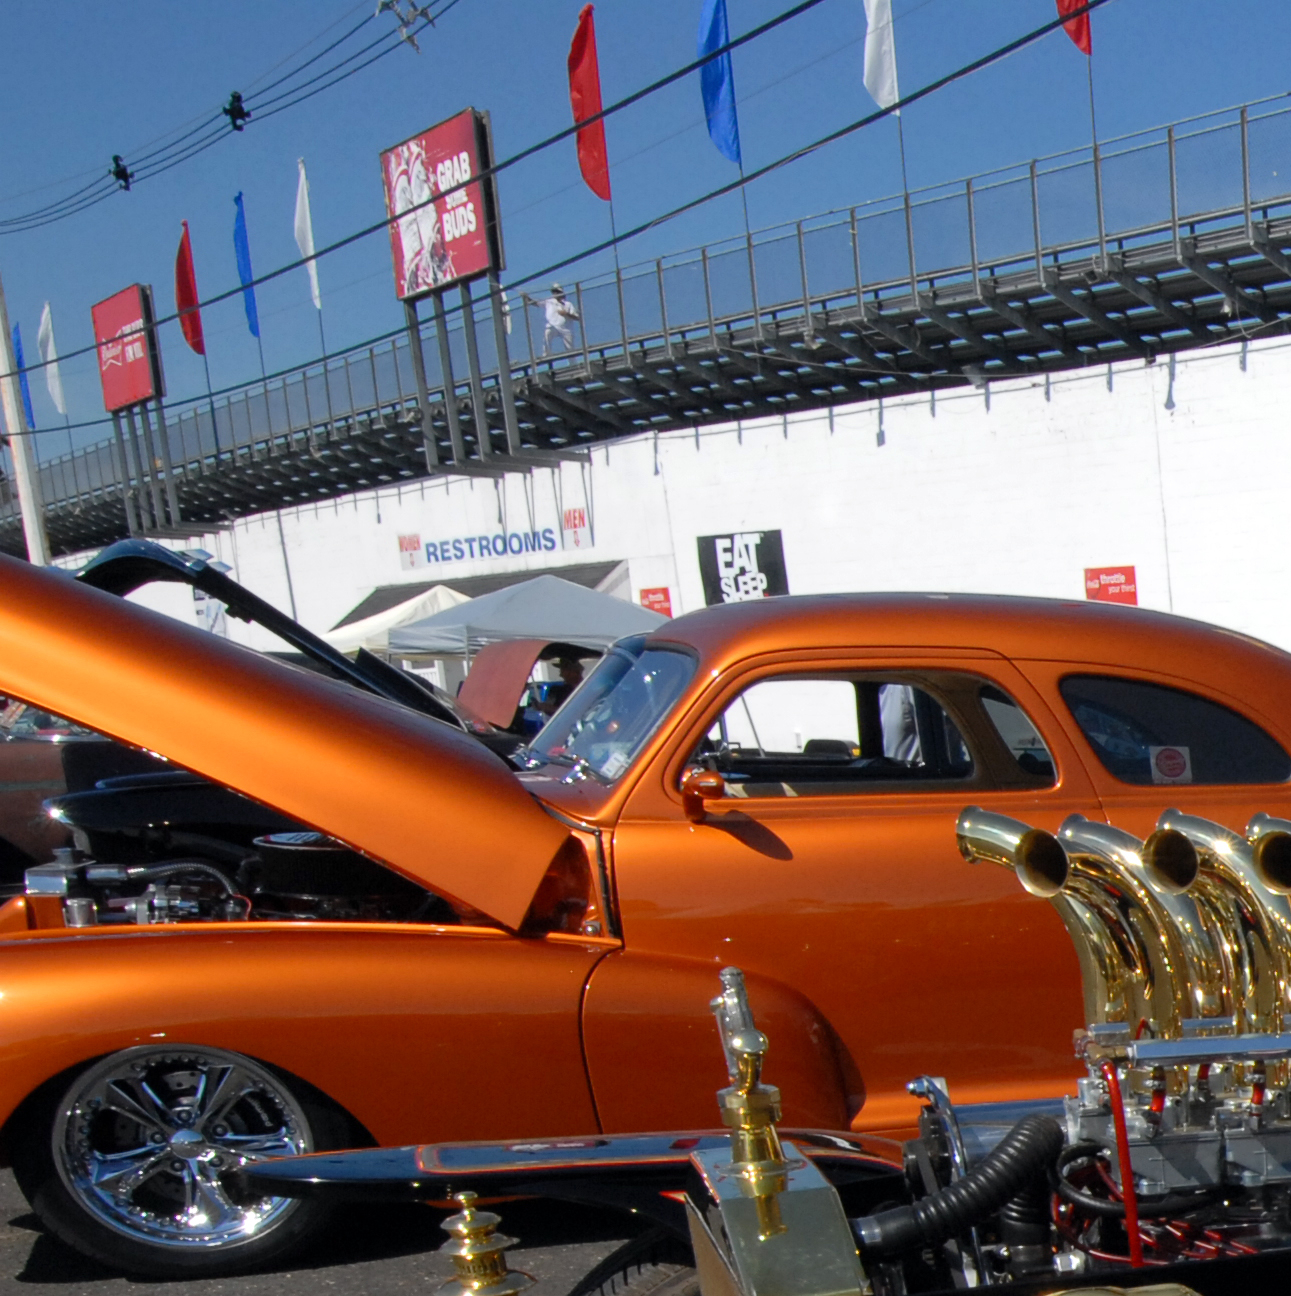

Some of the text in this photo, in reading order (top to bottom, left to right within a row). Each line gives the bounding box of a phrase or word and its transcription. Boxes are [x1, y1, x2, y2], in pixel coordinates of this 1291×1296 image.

[437, 151, 471, 192] GRAB
[442, 202, 477, 242] BUDS
[563, 508, 586, 530] MEN
[425, 528, 557, 563] RESTROOMS
[715, 533, 761, 578] EAT
[720, 572, 768, 600] SLEEP
